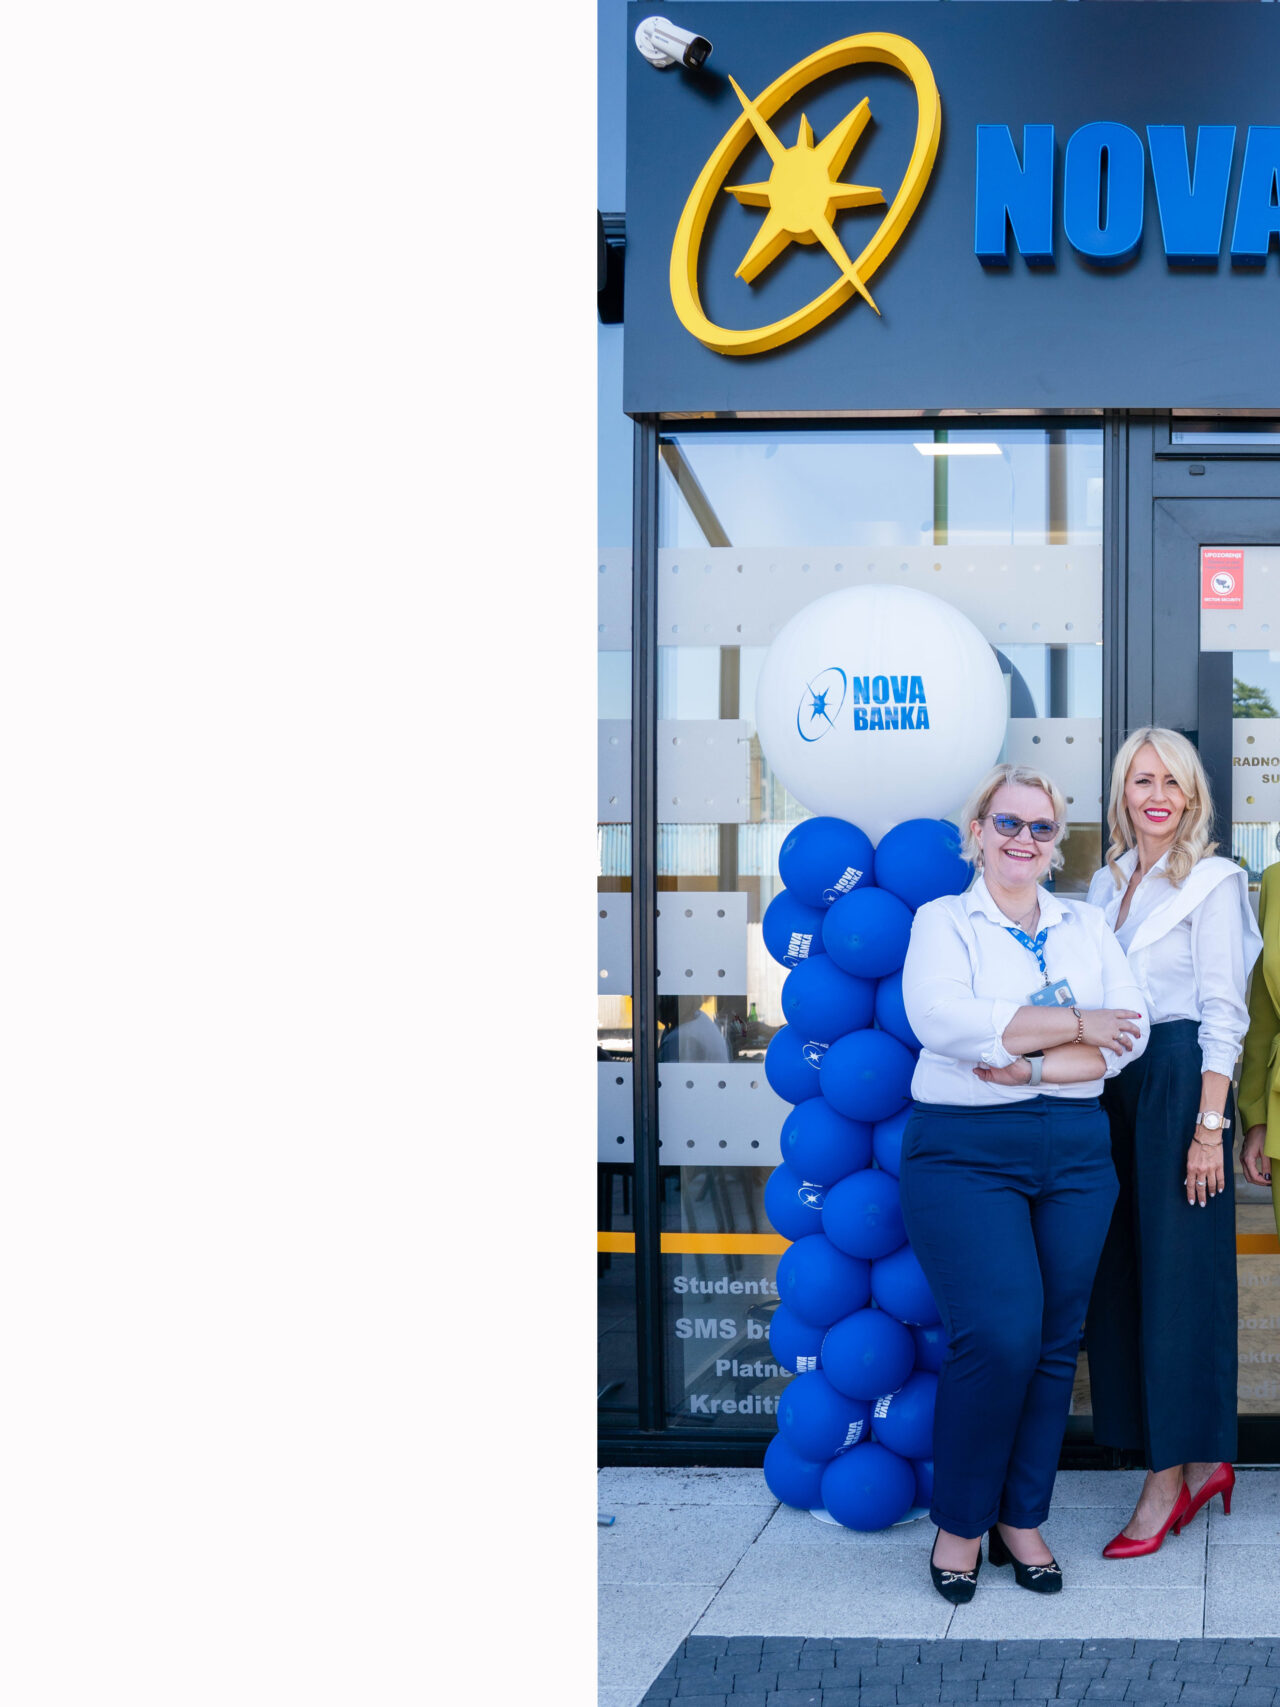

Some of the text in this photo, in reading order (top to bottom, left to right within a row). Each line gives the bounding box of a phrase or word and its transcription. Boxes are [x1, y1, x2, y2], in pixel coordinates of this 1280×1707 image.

[852, 675, 927, 705] NOVA
[853, 705, 930, 731] BANKA
[1232, 757, 1280, 767] RADNO
[833, 866, 857, 892] NOVA
[841, 870, 864, 894] BANKA
[787, 932, 803, 957] NOVA
[798, 934, 813, 959] BANKA
[675, 1317, 738, 1339] SMS
[842, 1421, 858, 1447] NOVA
